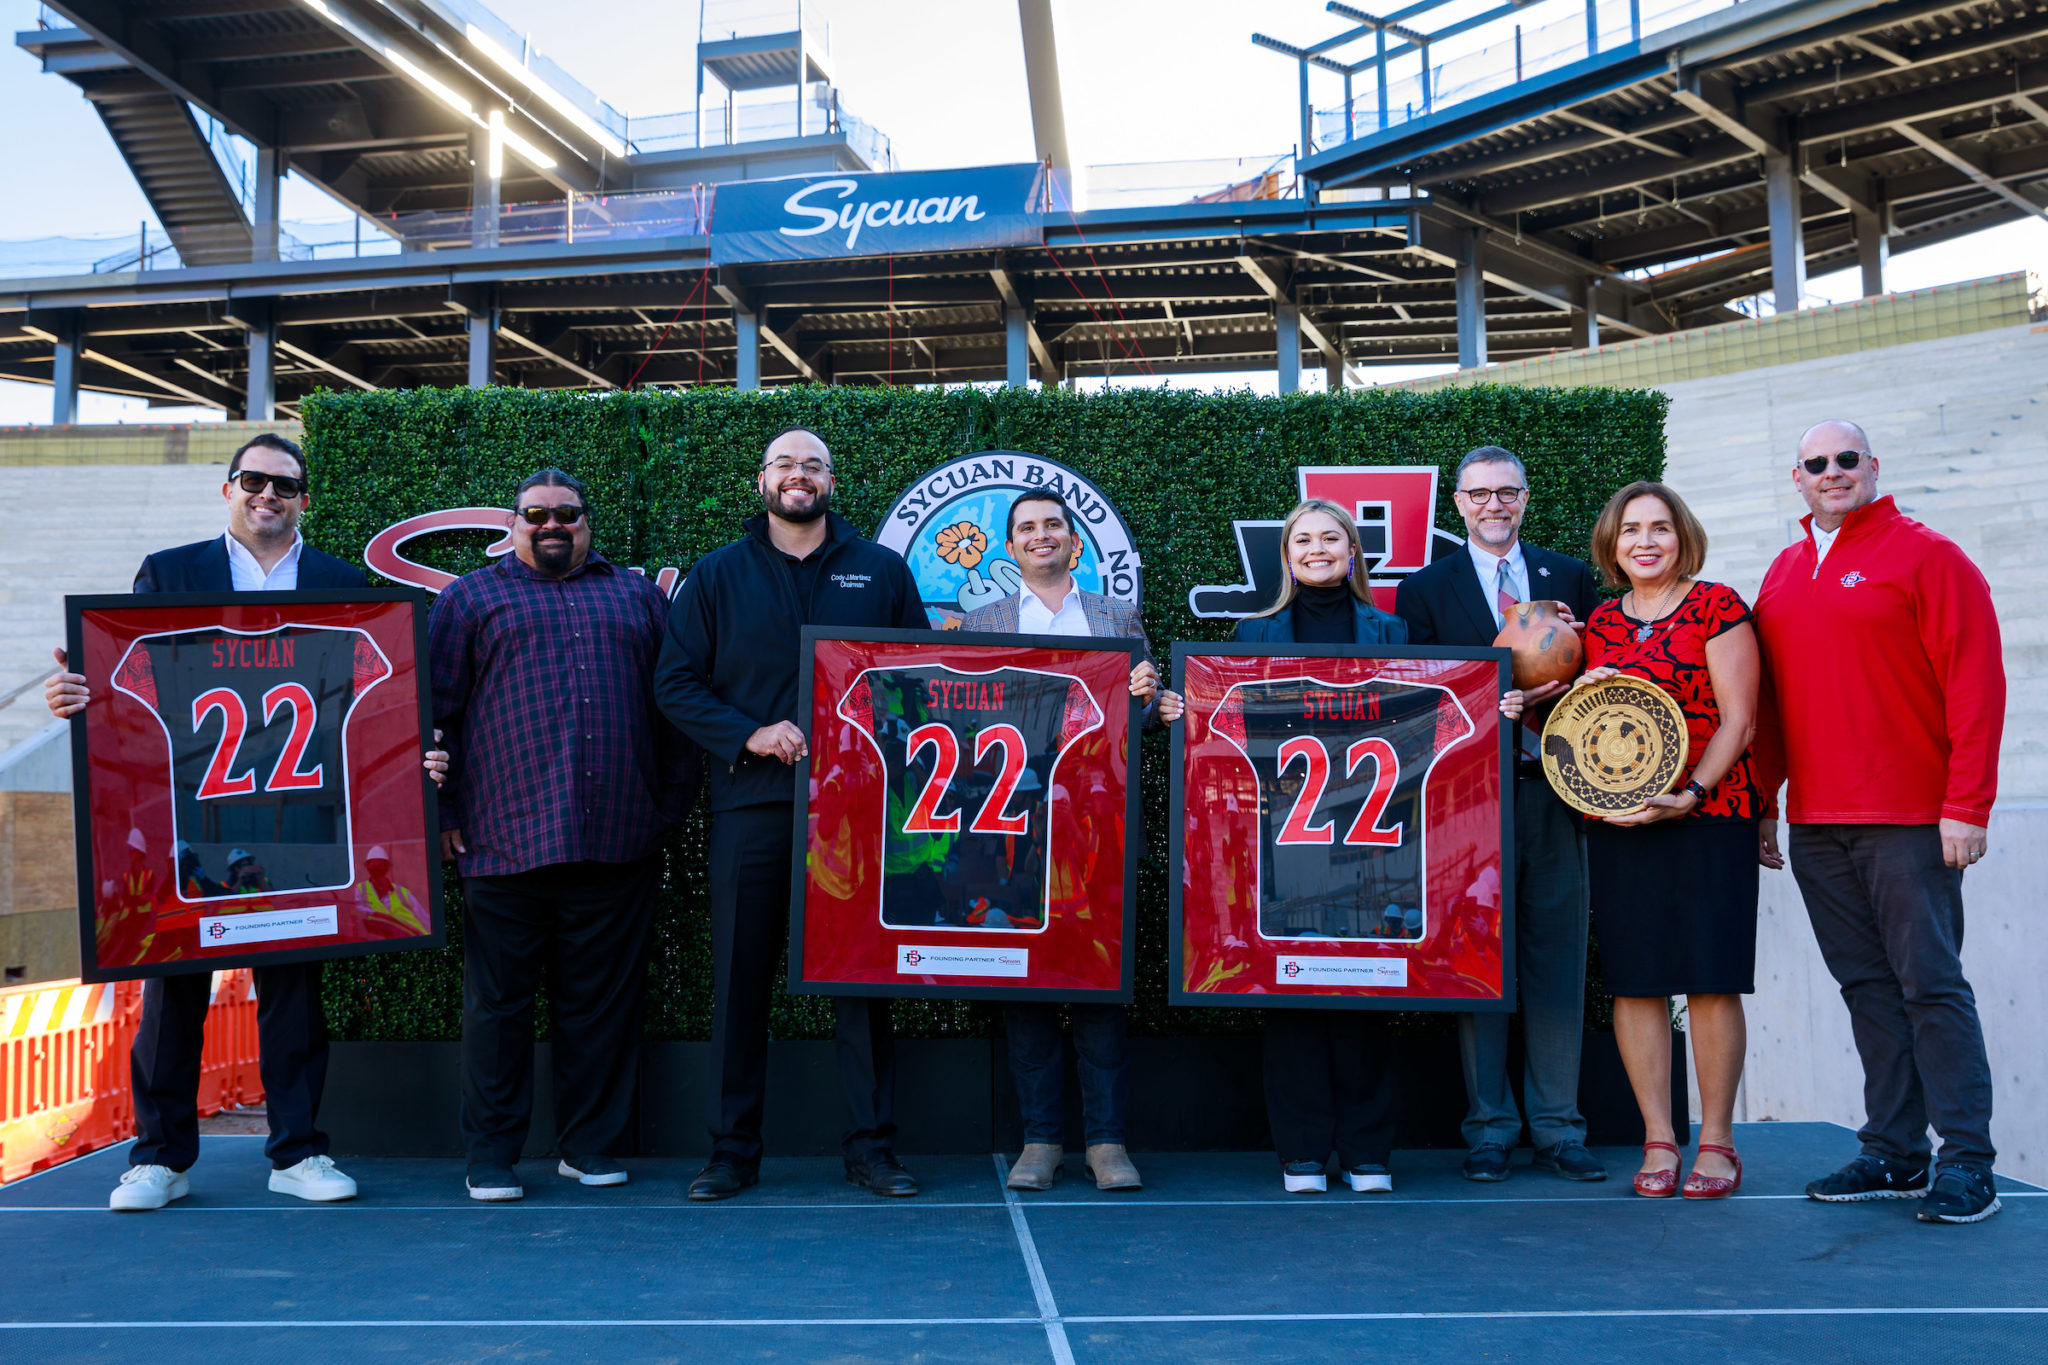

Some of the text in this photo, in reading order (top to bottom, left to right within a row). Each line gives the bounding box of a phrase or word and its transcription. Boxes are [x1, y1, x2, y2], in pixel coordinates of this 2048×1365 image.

[779, 179, 985, 250] Sycuan
[897, 459, 1107, 527] SYCUAN BAND
[831, 573, 845, 582] Cody
[211, 638, 295, 668] SYCUAN
[927, 679, 1005, 711] SYCUAN
[1303, 690, 1380, 721] SYCUAN
[192, 681, 323, 801] 22
[902, 722, 1029, 836] 22
[1275, 735, 1403, 847] 22
[235, 922, 271, 930] FOUNDING
[272, 919, 304, 927] PARTNER
